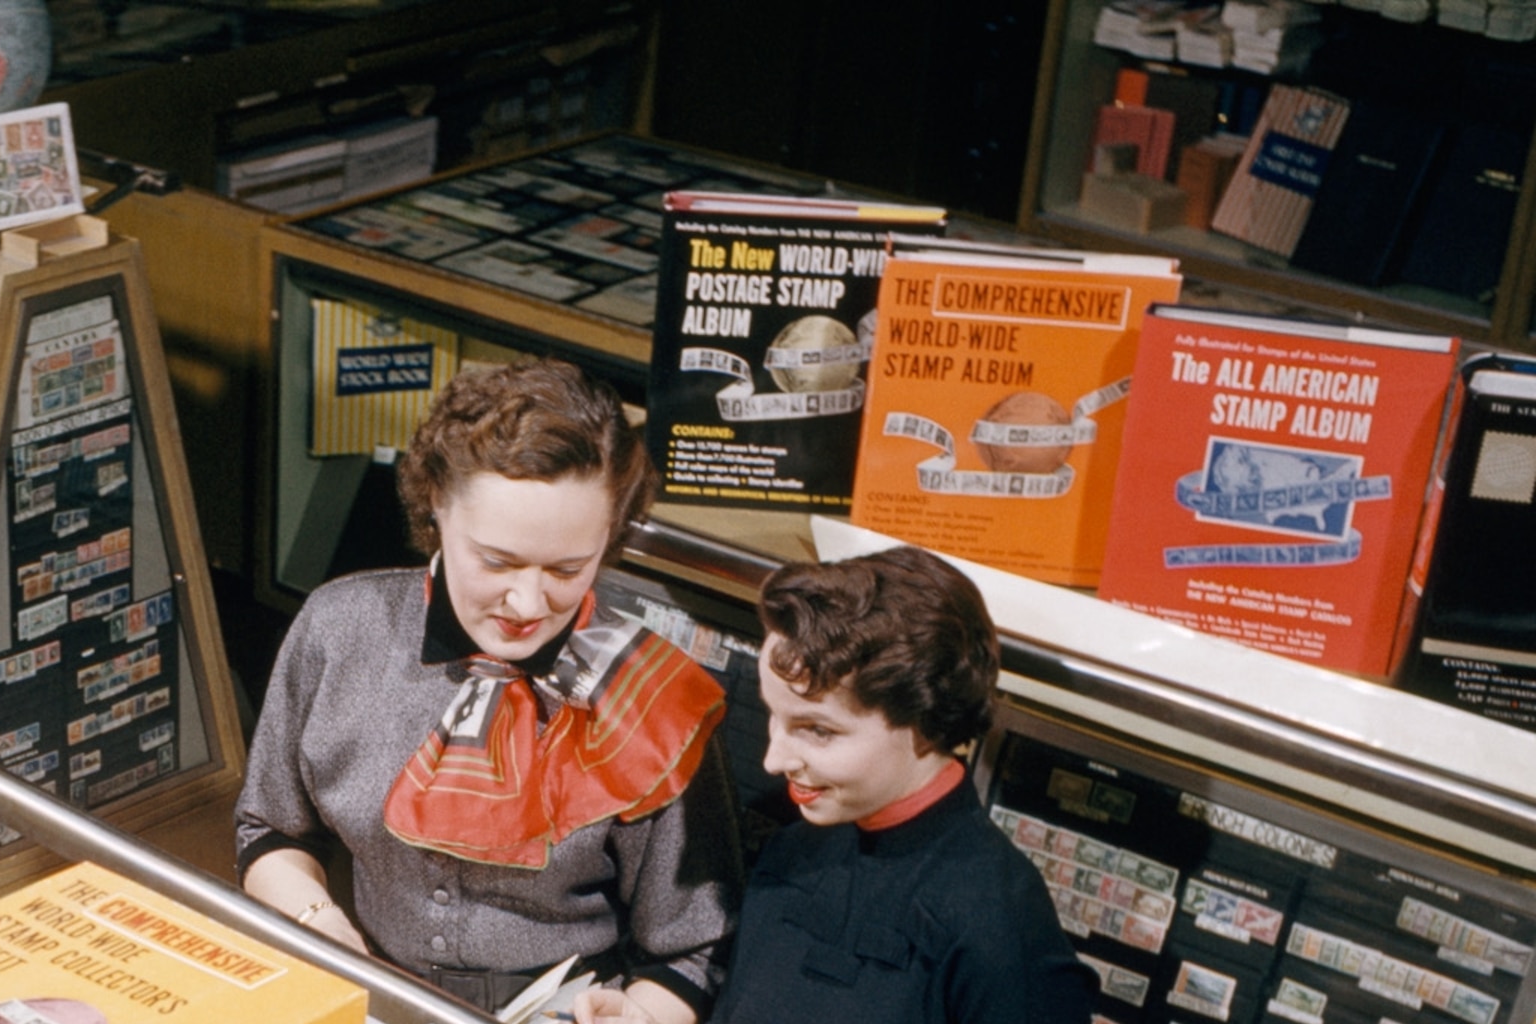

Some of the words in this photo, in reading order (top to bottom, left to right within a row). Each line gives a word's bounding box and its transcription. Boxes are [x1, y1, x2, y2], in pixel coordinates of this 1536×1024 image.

[690, 239, 726, 268] The
[731, 241, 775, 271] New
[779, 244, 886, 277] WORLD-WID
[686, 271, 774, 305] POSTAGE
[776, 277, 845, 309] STAMP
[894, 278, 931, 307] THE
[941, 281, 1121, 320] COMPREHENSIVE
[682, 305, 752, 338] ALBUM
[889, 318, 1020, 352] WORLD-WIDE
[884, 353, 954, 382] STAMP
[961, 358, 1035, 387] ALBUM
[1171, 351, 1211, 385] The
[1215, 357, 1255, 391] ALL
[1259, 363, 1380, 407] AMERICAN
[1210, 393, 1287, 432] STAMP
[1289, 404, 1372, 445] ALBUM
[20, 896, 150, 964] WORLD-WIDE
[60, 879, 109, 907] THE
[97, 897, 277, 984] COMPREHENSIVE
[50, 951, 189, 1015] COLLECTOR'S
